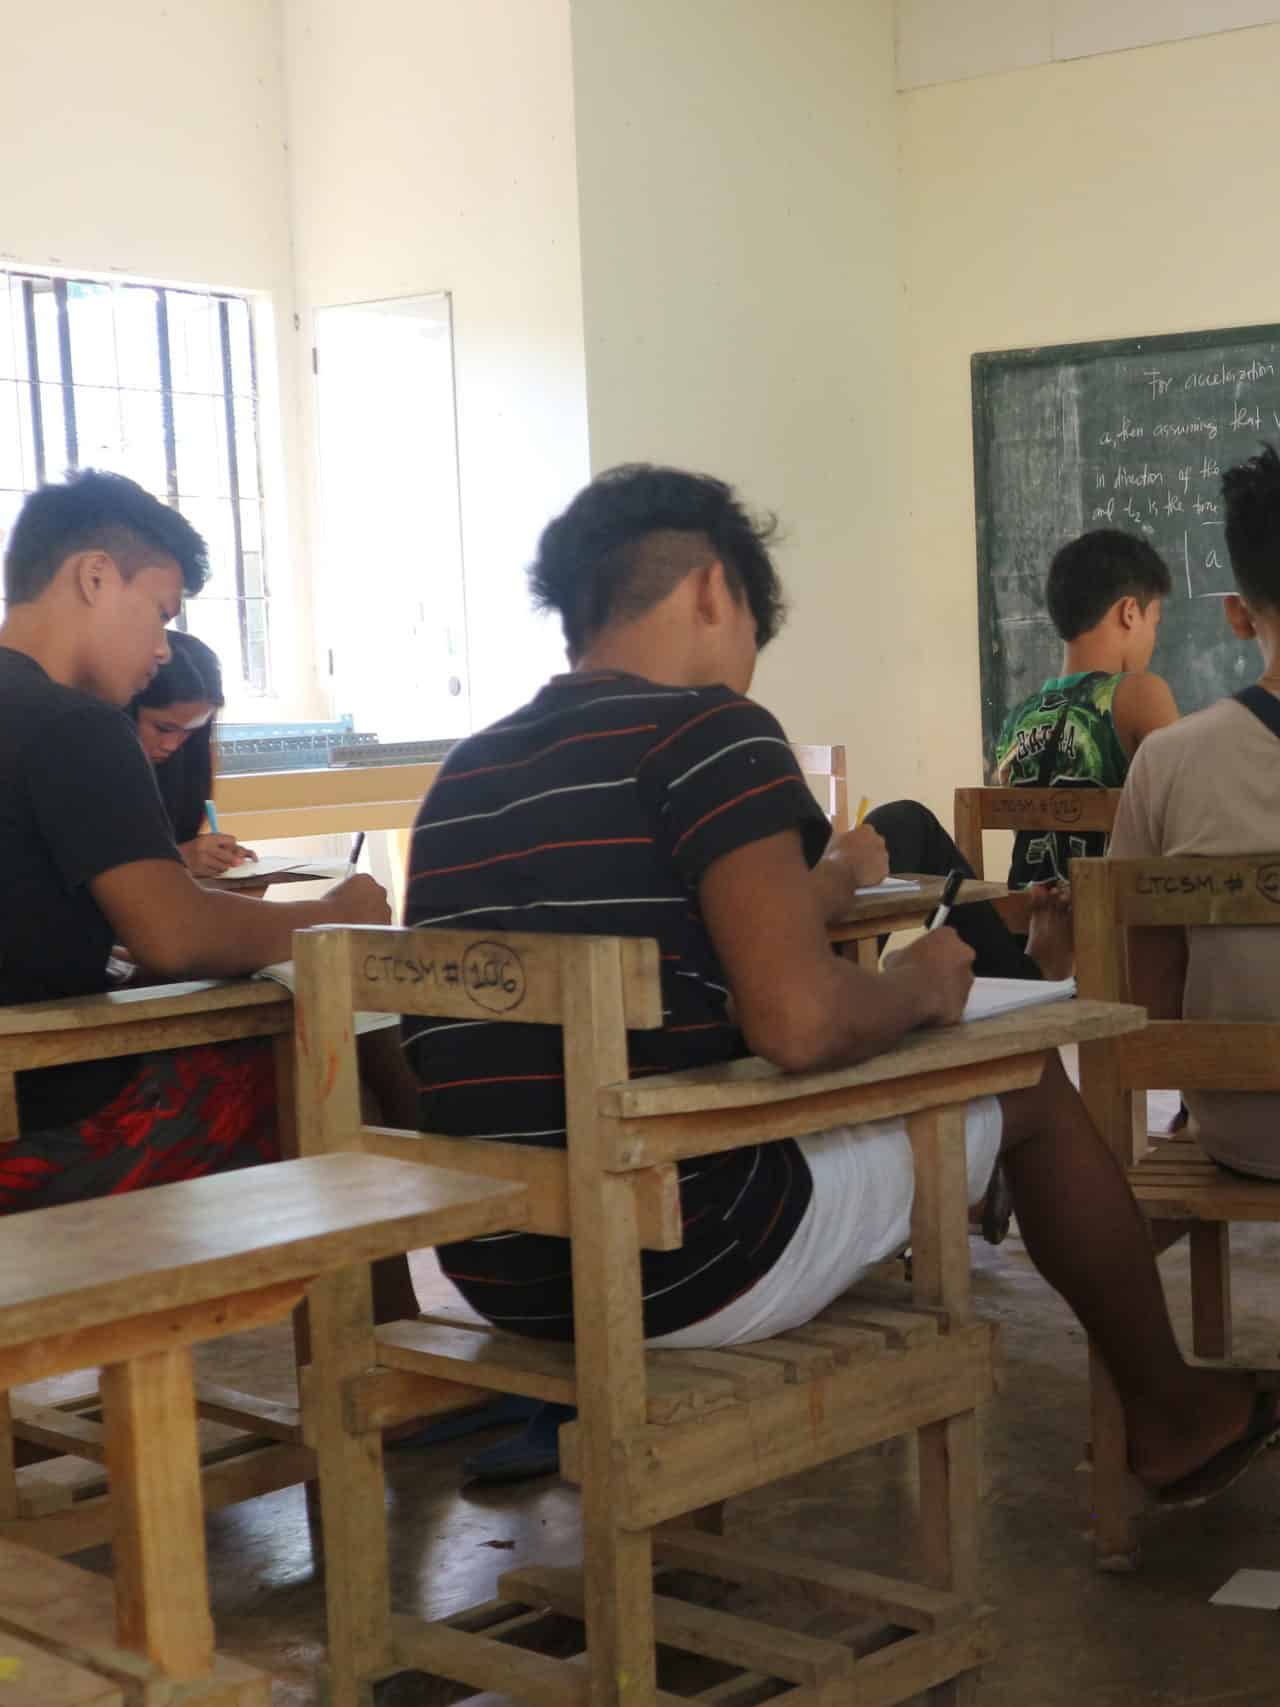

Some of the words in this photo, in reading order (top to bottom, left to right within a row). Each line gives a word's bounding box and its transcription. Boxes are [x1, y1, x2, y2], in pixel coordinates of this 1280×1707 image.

[1143, 370, 1174, 400] For
[1152, 417, 1218, 440] assuming
[1230, 400, 1263, 432] that
[1113, 464, 1165, 489] direction
[1178, 464, 1194, 495] of
[1199, 455, 1221, 481] the
[1148, 497, 1159, 518] is
[1161, 490, 1186, 518] the
[1224, 872, 1245, 893] #
[363, 954, 438, 984] CTCSM
[443, 964, 460, 983] #
